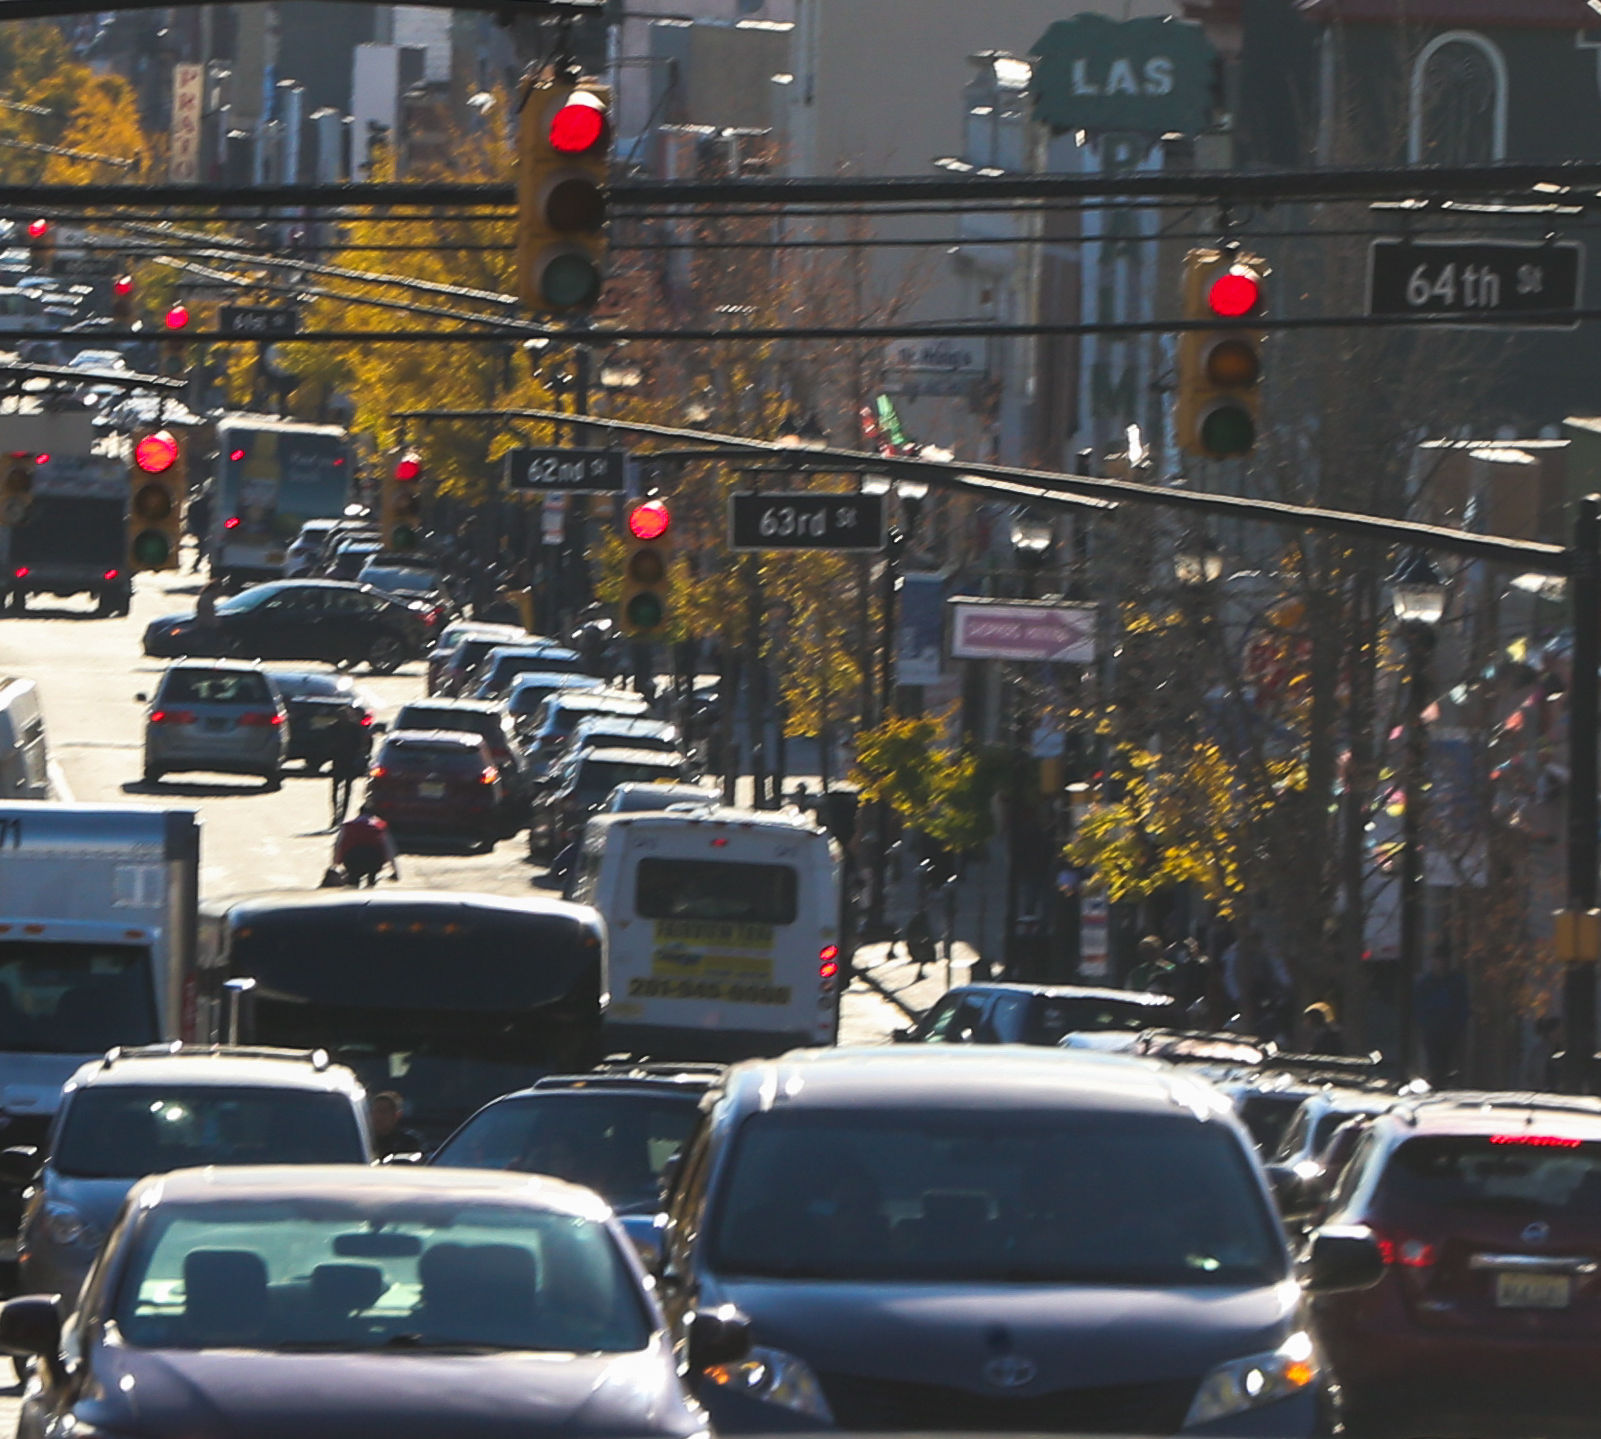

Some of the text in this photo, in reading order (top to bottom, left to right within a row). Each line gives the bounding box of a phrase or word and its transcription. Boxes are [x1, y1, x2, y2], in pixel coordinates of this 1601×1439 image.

[1071, 56, 1175, 97] LAS
[1406, 261, 1544, 308] 64th St
[527, 457, 586, 483] 62nd
[759, 506, 858, 537] 63rd St
